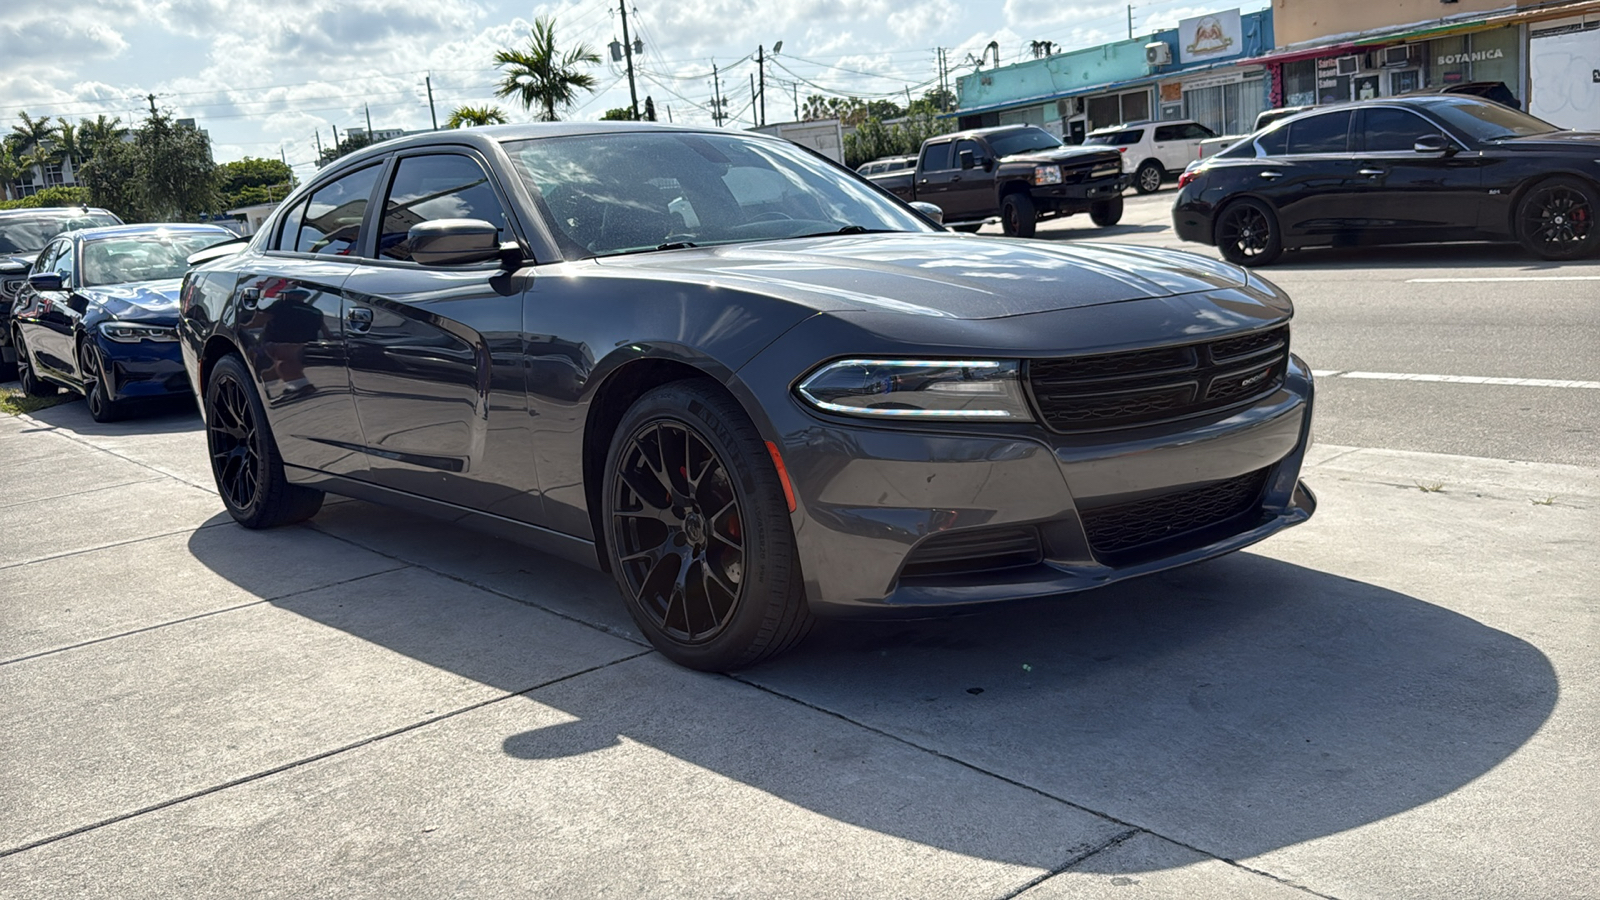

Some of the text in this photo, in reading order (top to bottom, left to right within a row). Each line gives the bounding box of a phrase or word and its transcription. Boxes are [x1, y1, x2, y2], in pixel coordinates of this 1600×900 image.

[1437, 49, 1503, 65] BOTANICA
[1318, 68, 1337, 78] Beaut
[1318, 79, 1337, 89] Salon
